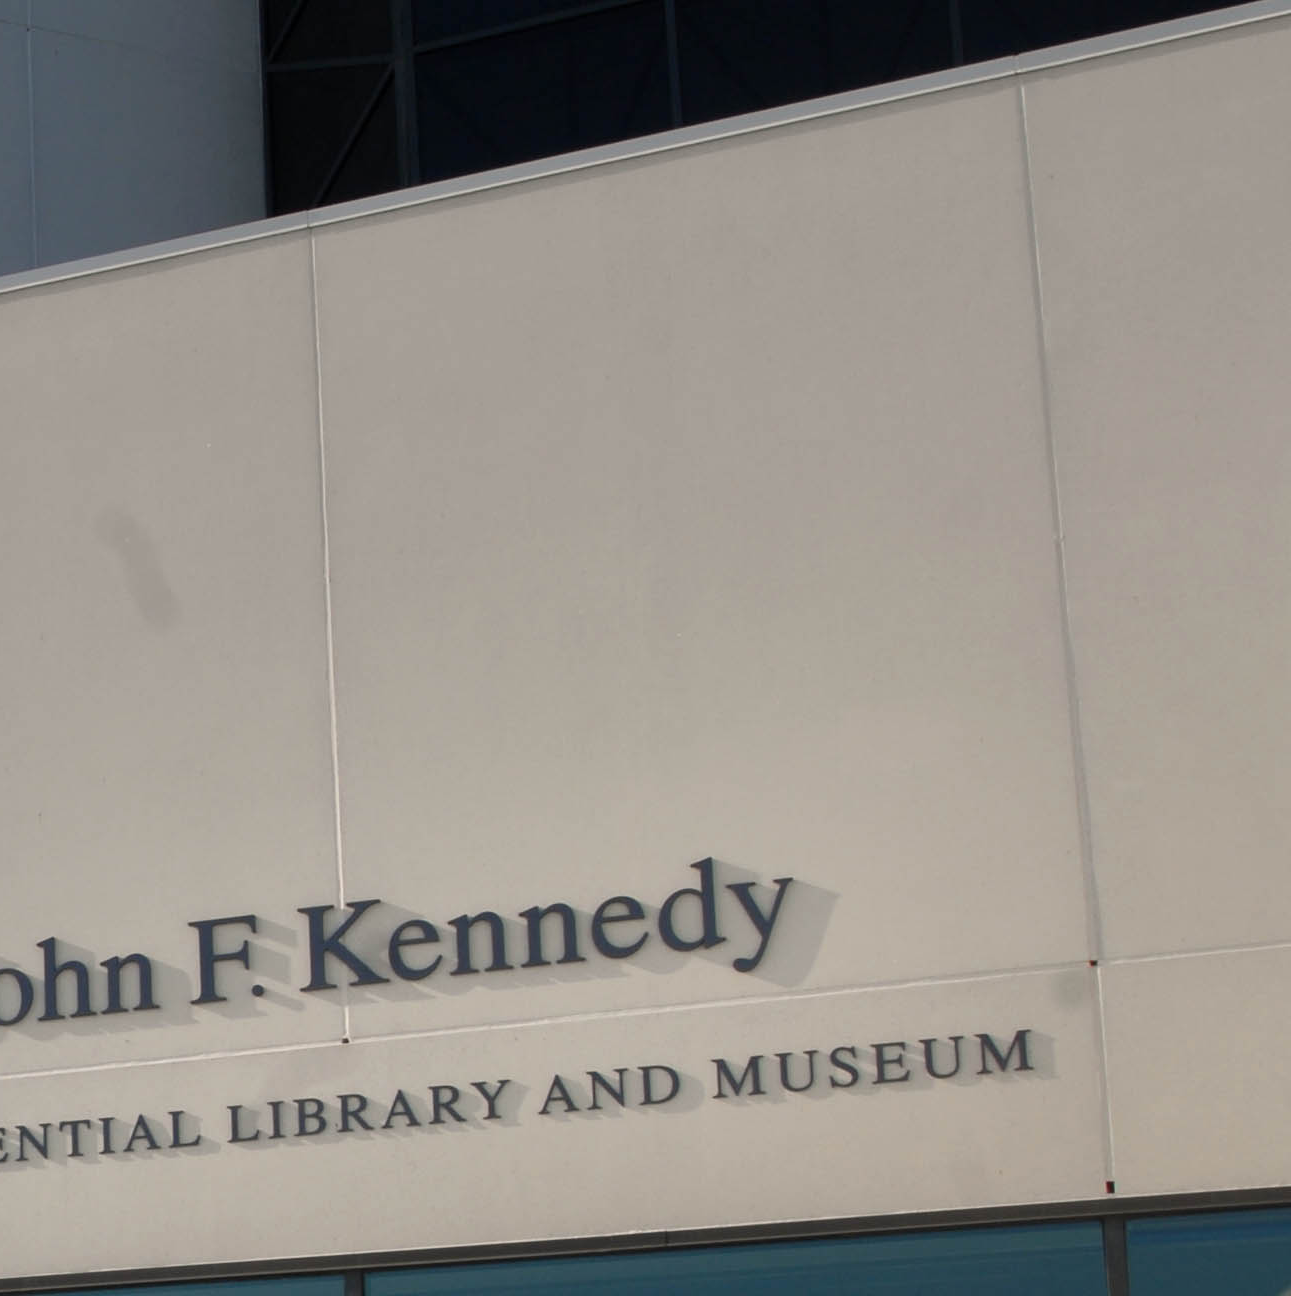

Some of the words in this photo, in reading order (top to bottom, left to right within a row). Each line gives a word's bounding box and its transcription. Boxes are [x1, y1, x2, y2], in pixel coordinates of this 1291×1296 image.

[187, 913, 266, 1005] F.
[296, 856, 795, 993] Kennedy
[226, 1079, 512, 1144] LIBRARY
[537, 1064, 682, 1116] AND
[710, 1028, 1035, 1100] MUSEUM
